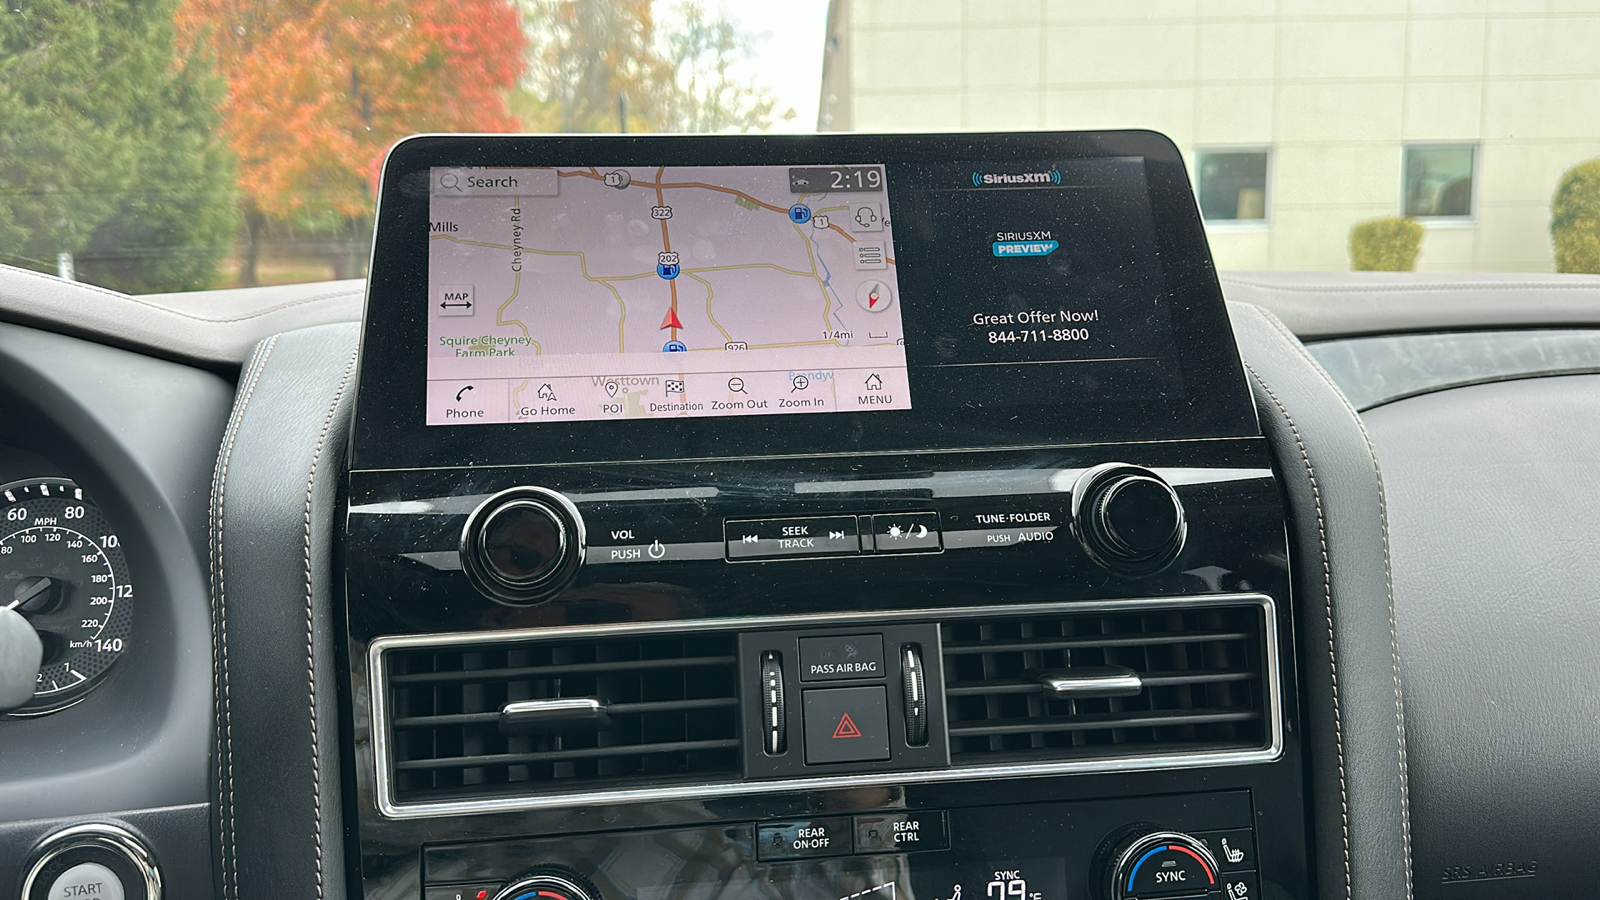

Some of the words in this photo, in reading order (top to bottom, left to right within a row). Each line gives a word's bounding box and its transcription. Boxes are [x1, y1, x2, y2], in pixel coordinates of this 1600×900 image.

[467, 175, 518, 189] Search
[830, 170, 881, 190] 2:19
[511, 208, 521, 222] Rd
[653, 208, 671, 219] 322
[429, 221, 459, 233] Mills
[996, 230, 1052, 242] SIRIUSXM
[511, 223, 524, 272] Cheyney
[998, 243, 1053, 254] PREVIEW
[661, 252, 678, 264] 202
[444, 292, 469, 301] MAP
[973, 312, 1014, 325] Great
[1017, 311, 1057, 324] Offer
[1060, 309, 1099, 322] Now!
[439, 336, 478, 346] Squire
[481, 335, 532, 346] Cheyney
[988, 328, 1089, 344] 844-711-8800
[455, 348, 486, 357] Farm
[489, 346, 515, 357] Park
[711, 399, 744, 410] Zoom
[747, 398, 769, 409] Out
[778, 397, 811, 408] Zoom
[814, 395, 825, 407] In
[858, 393, 893, 405] MENU
[520, 406, 538, 416] Go
[541, 405, 576, 416] Home
[603, 403, 624, 414] POI
[650, 401, 704, 412] Destination
[446, 407, 484, 418] Phone
[7, 507, 28, 521] 60
[64, 506, 85, 519] 80
[34, 517, 57, 526] MPH
[611, 530, 635, 540] VOL
[782, 526, 808, 536] SEEK
[20, 534, 37, 543] 100
[45, 533, 61, 542] 120
[100, 535, 121, 548] 10
[987, 534, 1011, 543] PUSH
[1018, 531, 1054, 542] AUDIO
[67, 539, 83, 549] 140
[778, 538, 814, 549] TRACK
[81, 554, 98, 563] 160
[611, 549, 641, 560] PUSH
[91, 575, 108, 583] 180
[90, 597, 108, 605] 200
[81, 619, 98, 628] 220
[69, 640, 93, 649] km/h
[95, 639, 123, 652] 140
[810, 664, 835, 674] PASS
[836, 663, 853, 673] AIR
[855, 662, 877, 672] BAG
[893, 821, 920, 831] REAR
[798, 828, 825, 838] REAR
[893, 832, 920, 843] CTRL
[994, 869, 1021, 880] SYNC
[1442, 866, 1472, 880] SRS
[1478, 860, 1538, 876] AIRBAG
[1155, 870, 1186, 883] SYNC
[63, 882, 103, 898] START
